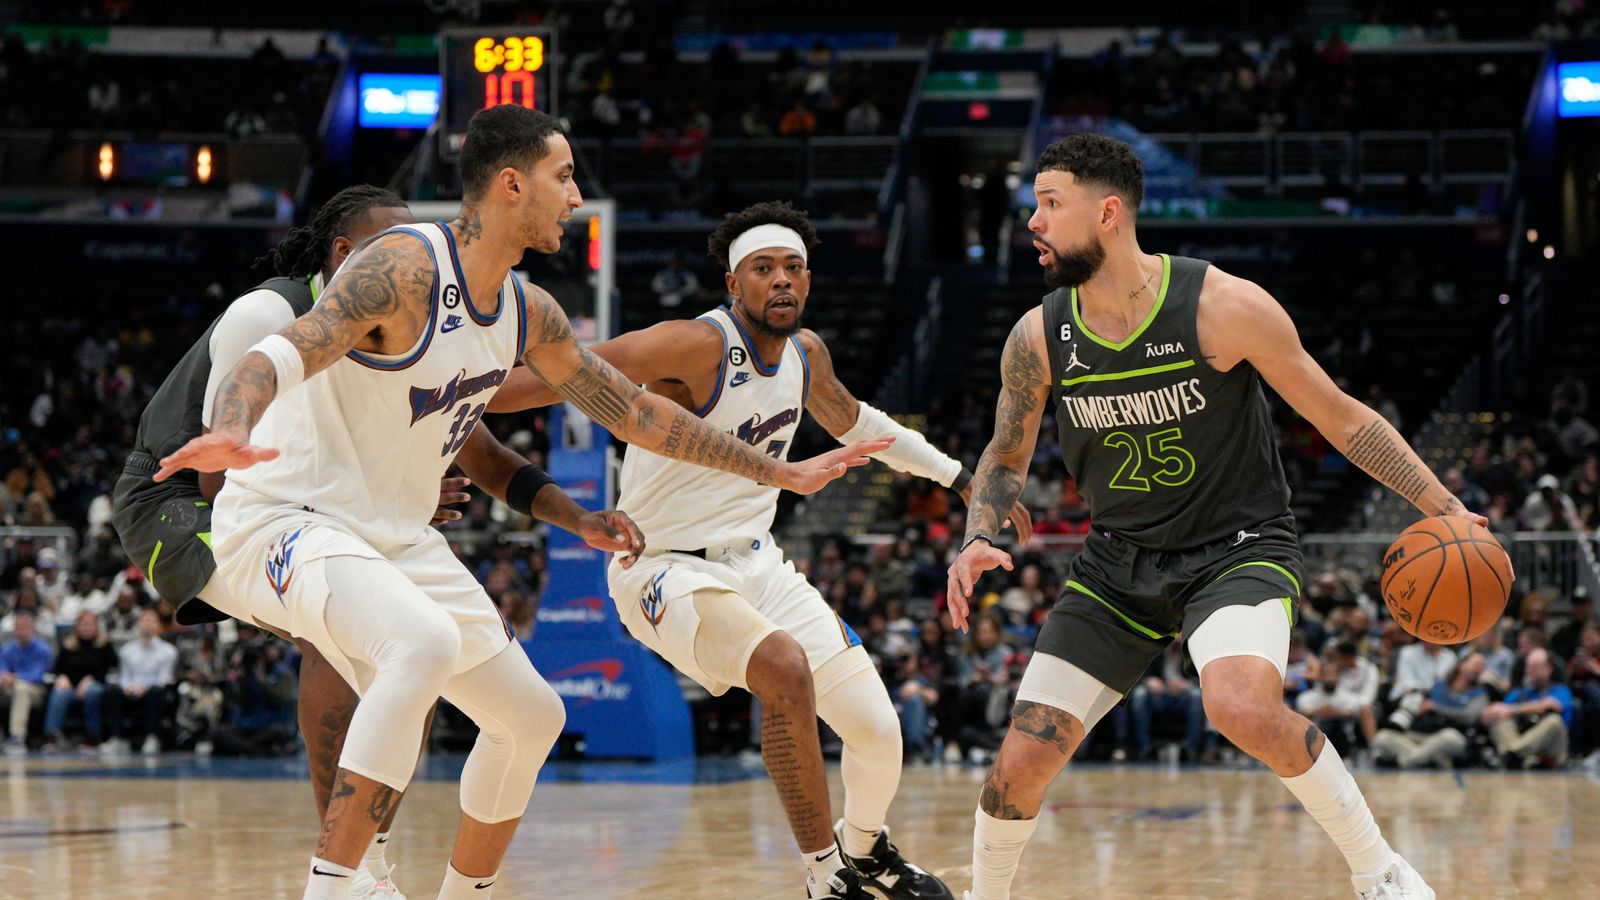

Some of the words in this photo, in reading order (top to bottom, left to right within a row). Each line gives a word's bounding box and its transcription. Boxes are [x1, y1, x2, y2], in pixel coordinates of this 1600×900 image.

[475, 36, 543, 72] 6:33
[445, 287, 458, 307] 6
[445, 314, 462, 326] NIKE
[1060, 323, 1072, 342] 6
[730, 349, 742, 365] 6
[734, 371, 749, 380] NIKE
[1062, 378, 1206, 433] TIMBERWOLVES
[441, 403, 485, 457] 33
[1104, 427, 1196, 491] 25
